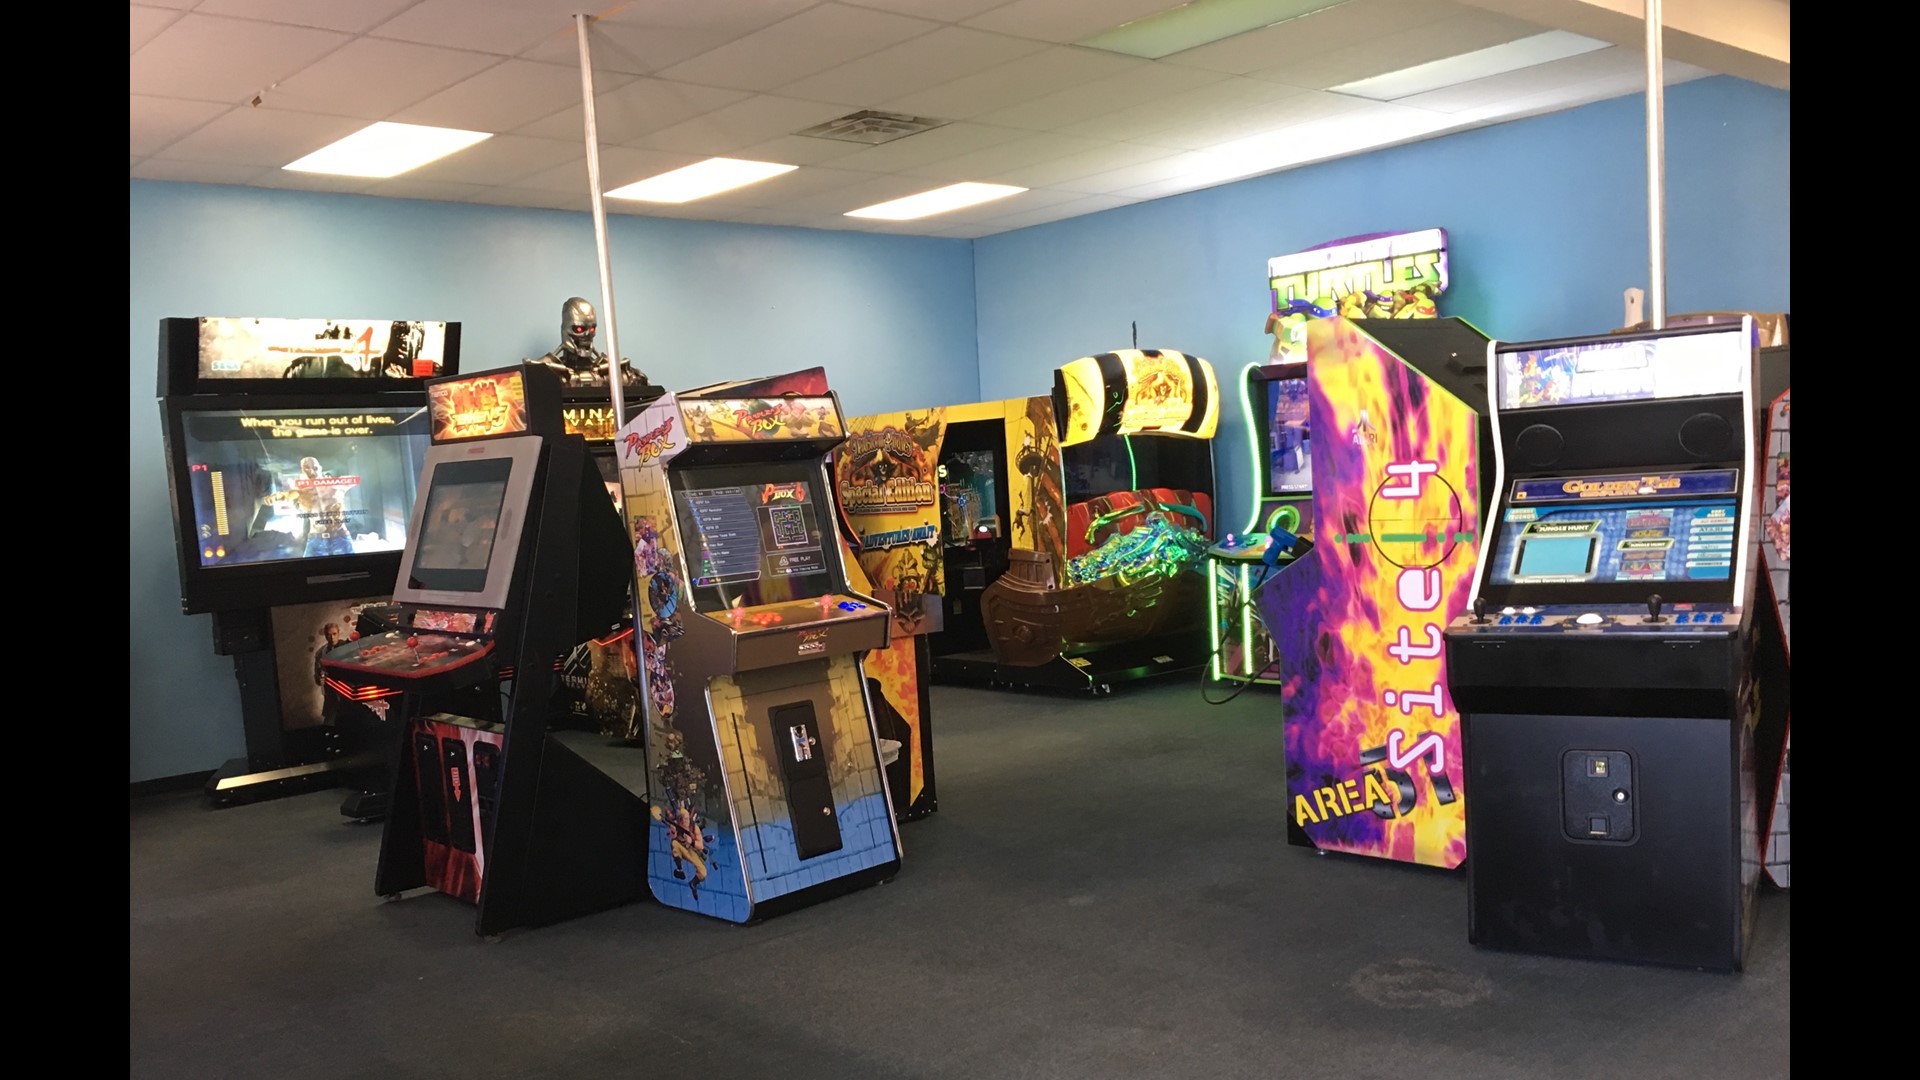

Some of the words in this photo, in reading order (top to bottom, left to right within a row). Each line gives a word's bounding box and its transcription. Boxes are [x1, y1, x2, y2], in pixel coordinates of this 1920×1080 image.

[1270, 249, 1440, 310] TURTLES
[241, 417, 278, 428] When
[280, 418, 302, 429] you
[305, 418, 326, 426] run
[330, 416, 349, 425] out
[352, 416, 363, 425] of
[272, 428, 292, 437] the
[296, 428, 329, 438] game
[330, 427, 341, 436] is
[344, 426, 373, 435] over.
[751, 413, 786, 437] BOX
[638, 432, 676, 472] BOX
[191, 464, 208, 472] P1
[1381, 459, 1437, 497] 4
[297, 480, 310, 488] P1
[841, 480, 884, 509] Special
[886, 477, 933, 505] Edition
[1562, 480, 1640, 494] GOLDEN
[1295, 773, 1392, 828] AREA
